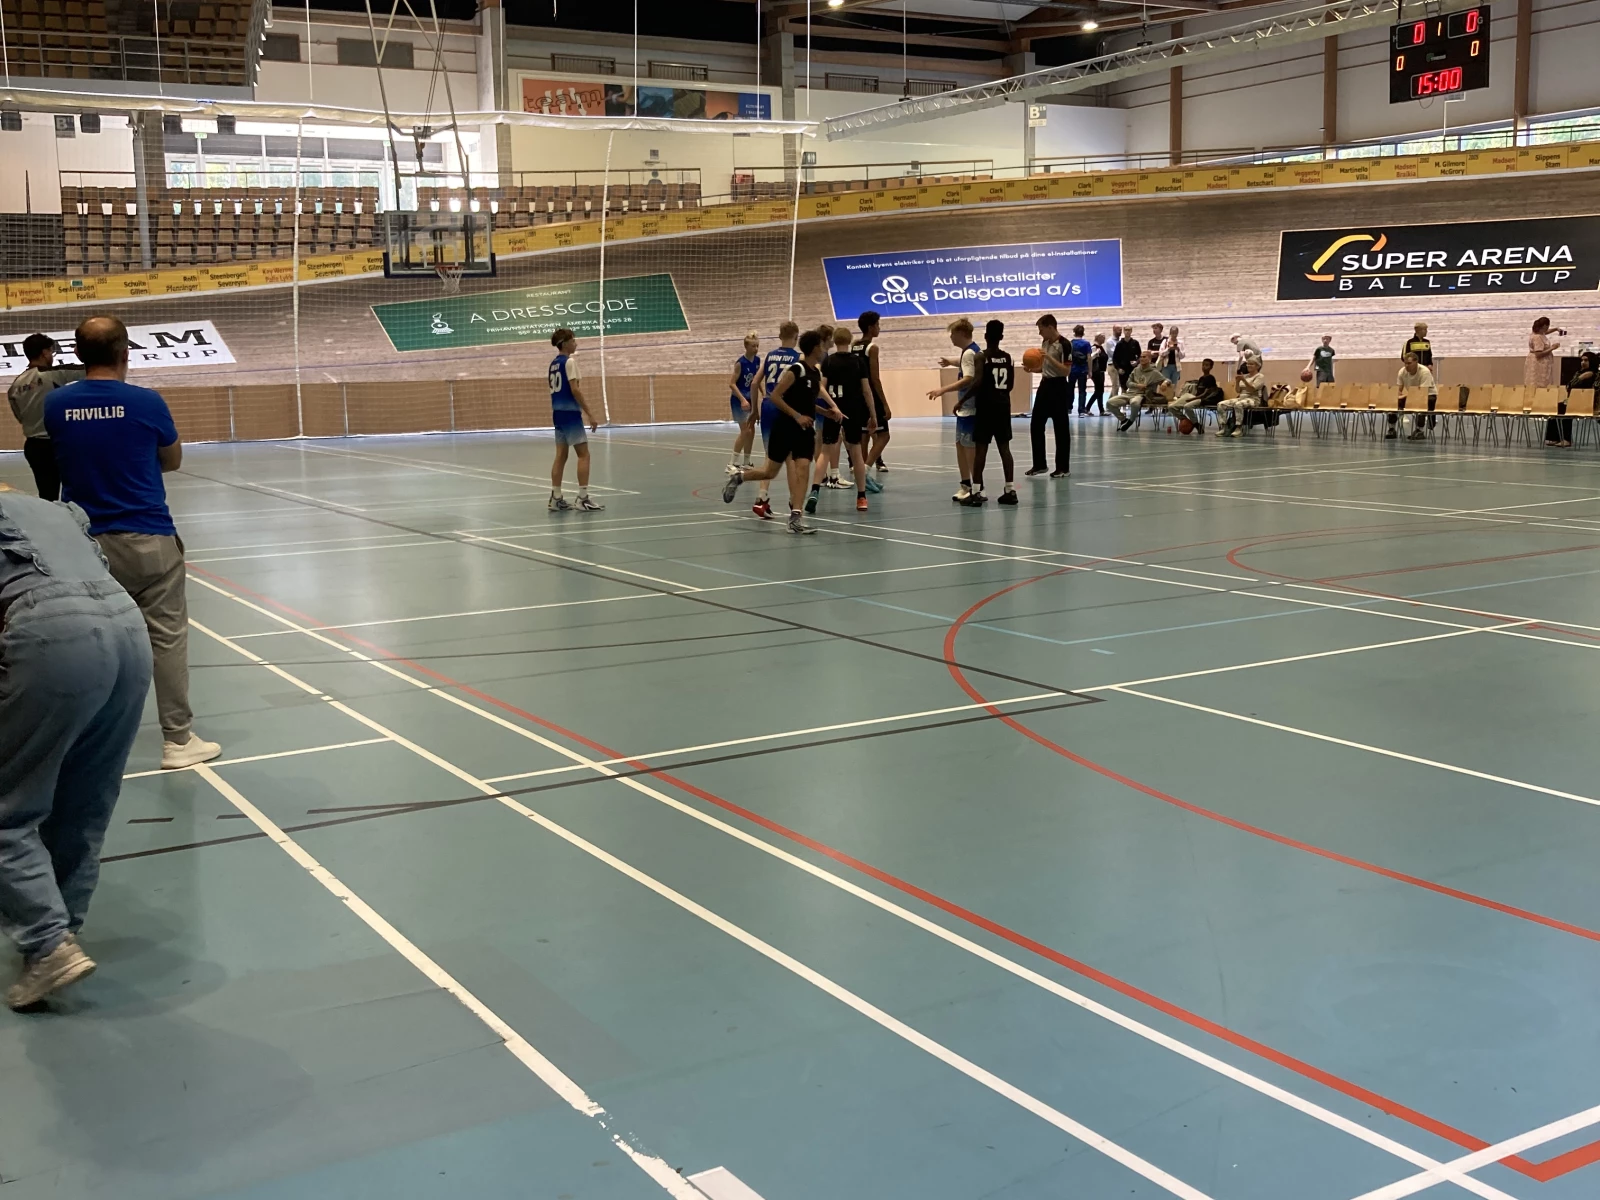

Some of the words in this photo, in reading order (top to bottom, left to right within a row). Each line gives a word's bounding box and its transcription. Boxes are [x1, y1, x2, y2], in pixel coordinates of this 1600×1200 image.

[1465, 11, 1478, 33] 0
[1413, 22, 1425, 44] 0
[1470, 40, 1479, 57] 0
[1396, 55, 1405, 71] 0
[1417, 67, 1461, 95] 15:00
[1492, 157, 1516, 165] Madsen
[1534, 153, 1561, 163] Slippens
[1394, 163, 1416, 171] Madsen
[1442, 160, 1466, 168] Gilmore
[1544, 161, 1561, 169] Stam
[1294, 169, 1321, 178] Veggerby
[1339, 166, 1369, 174] Martinello
[1440, 168, 1465, 176] McGrory
[1213, 174, 1228, 182] Clark
[1299, 177, 1321, 185] Madsen
[1355, 173, 1369, 181] Villa
[1077, 181, 1092, 189] Clark
[1111, 180, 1137, 189] Veggerby
[1206, 182, 1228, 190] Madsen
[946, 190, 960, 198] Clark
[989, 187, 1003, 195] Clark
[1072, 189, 1092, 197] Freuler
[979, 195, 1004, 203] Veggerby
[1022, 192, 1048, 200] Veggerby
[941, 197, 961, 205] Freuler
[815, 209, 831, 217] Doyle
[859, 205, 874, 213] Doyle
[846, 263, 872, 271] Kontakt
[953, 254, 998, 263] uforpligtende
[1047, 250, 1098, 258] el-installationer
[1341, 250, 1447, 271] SUPER
[1456, 245, 1573, 267] ARENA
[209, 272, 247, 281] Steenbergen
[932, 275, 962, 286] Aut.
[1339, 270, 1571, 291] BALLERUP
[526, 290, 572, 299] RESTAURANT
[870, 292, 929, 305] Claus
[933, 284, 1041, 302] Dalsgaard
[1046, 282, 1082, 298] a/s
[470, 312, 487, 324] A
[492, 298, 639, 321] DRESSCODE
[486, 323, 562, 333] FRIHAVNSSTATIONEN
[602, 317, 622, 325] LADS
[0, 329, 213, 358] TEM
[766, 363, 793, 384] 27
[992, 367, 1008, 390] 12
[65, 405, 126, 422] FRIVILLIG
